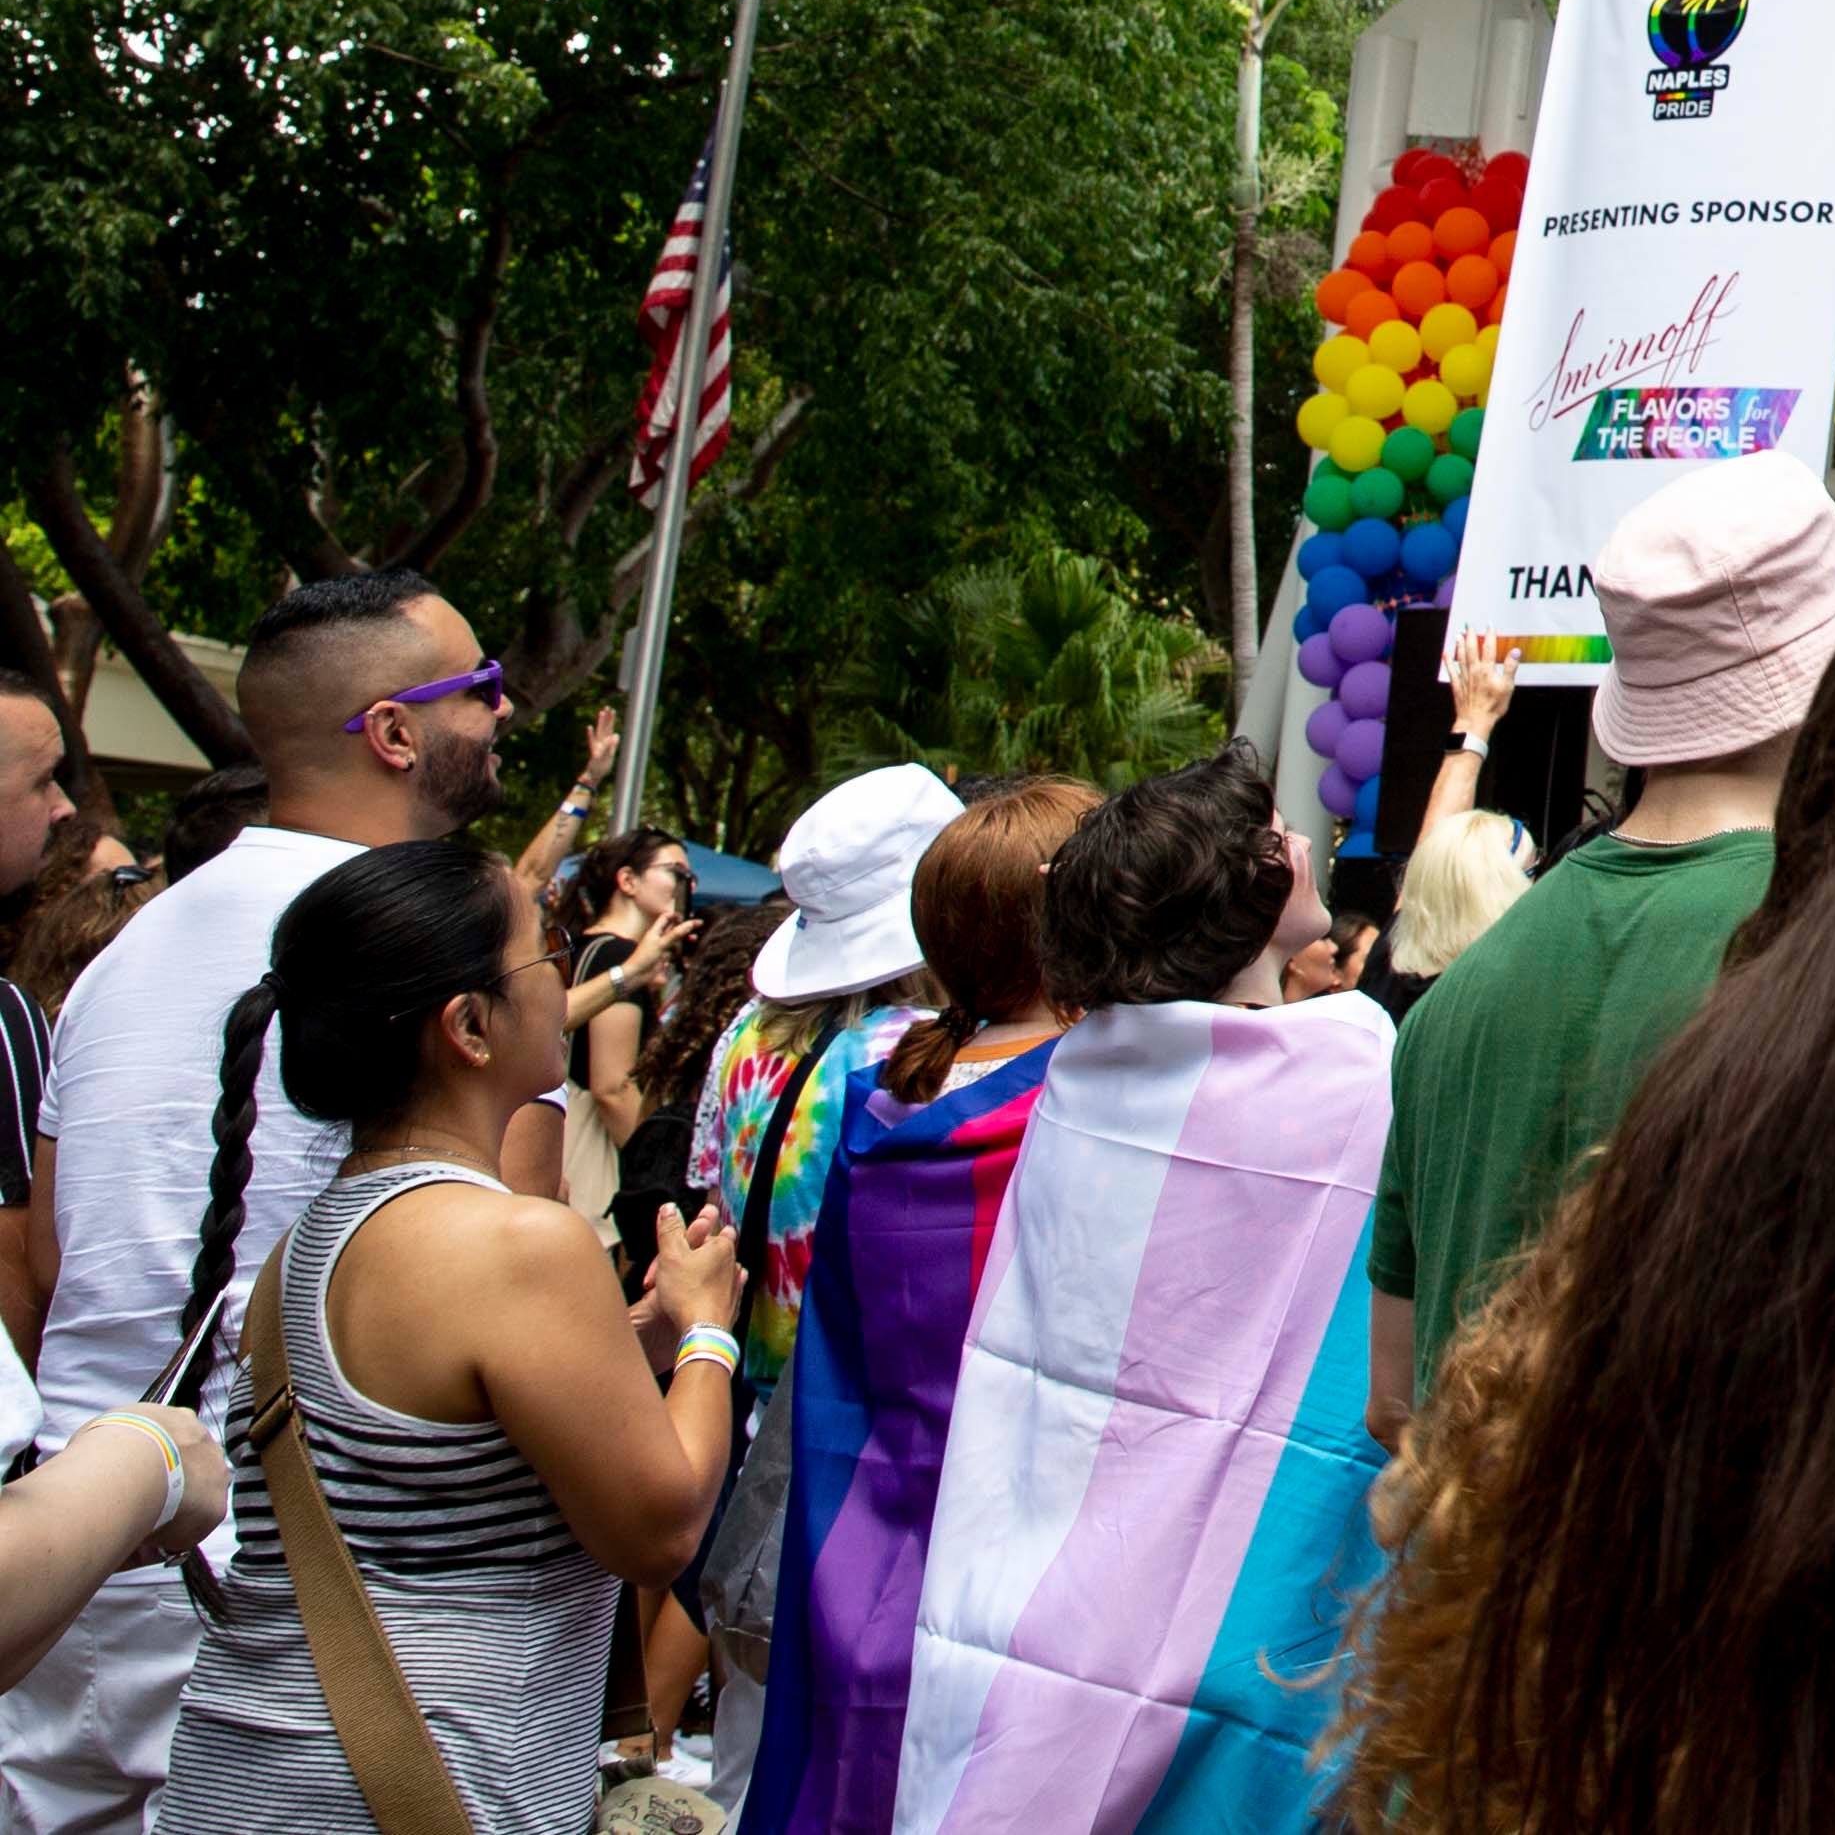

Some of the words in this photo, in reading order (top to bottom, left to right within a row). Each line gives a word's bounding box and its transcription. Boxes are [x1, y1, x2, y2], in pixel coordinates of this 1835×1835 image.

[1648, 68, 1727, 91] NAPLES
[1655, 100, 1711, 119] PRIDE
[1543, 201, 1680, 238] PRESENTING
[1690, 200, 1835, 224] SPONSOR
[1524, 271, 1742, 433] Smirnoff
[1611, 397, 1731, 421] FLAVORS
[1739, 395, 1771, 425] for
[1596, 428, 1645, 450] THE
[1651, 426, 1757, 450] PEOPLE
[1509, 564, 1597, 599] THAN
